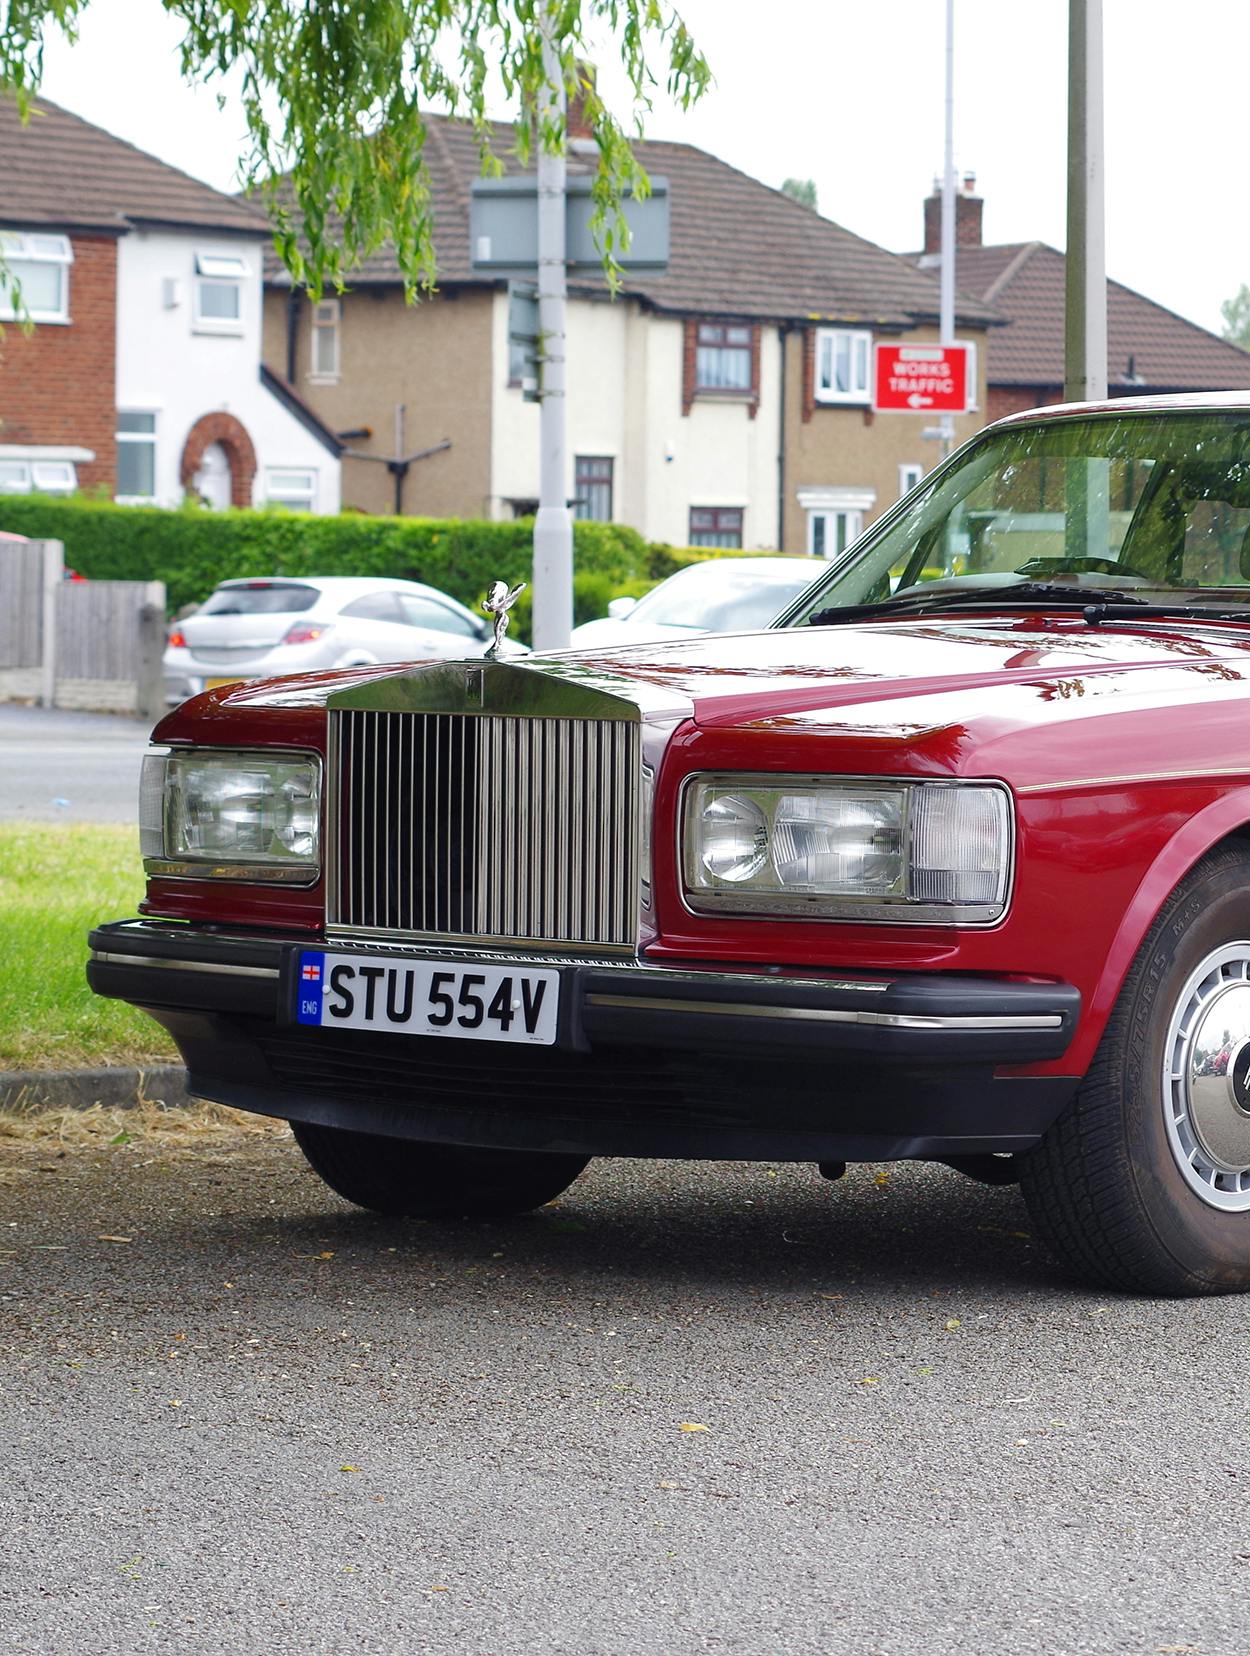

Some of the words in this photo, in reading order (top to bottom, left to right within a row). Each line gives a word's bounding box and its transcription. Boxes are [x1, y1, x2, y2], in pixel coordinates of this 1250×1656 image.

[892, 361, 951, 377] WORKS
[888, 377, 954, 394] TRAFFIC
[328, 964, 415, 1024] STU
[427, 971, 548, 1034] 554V
[302, 1000, 318, 1015] ENG
